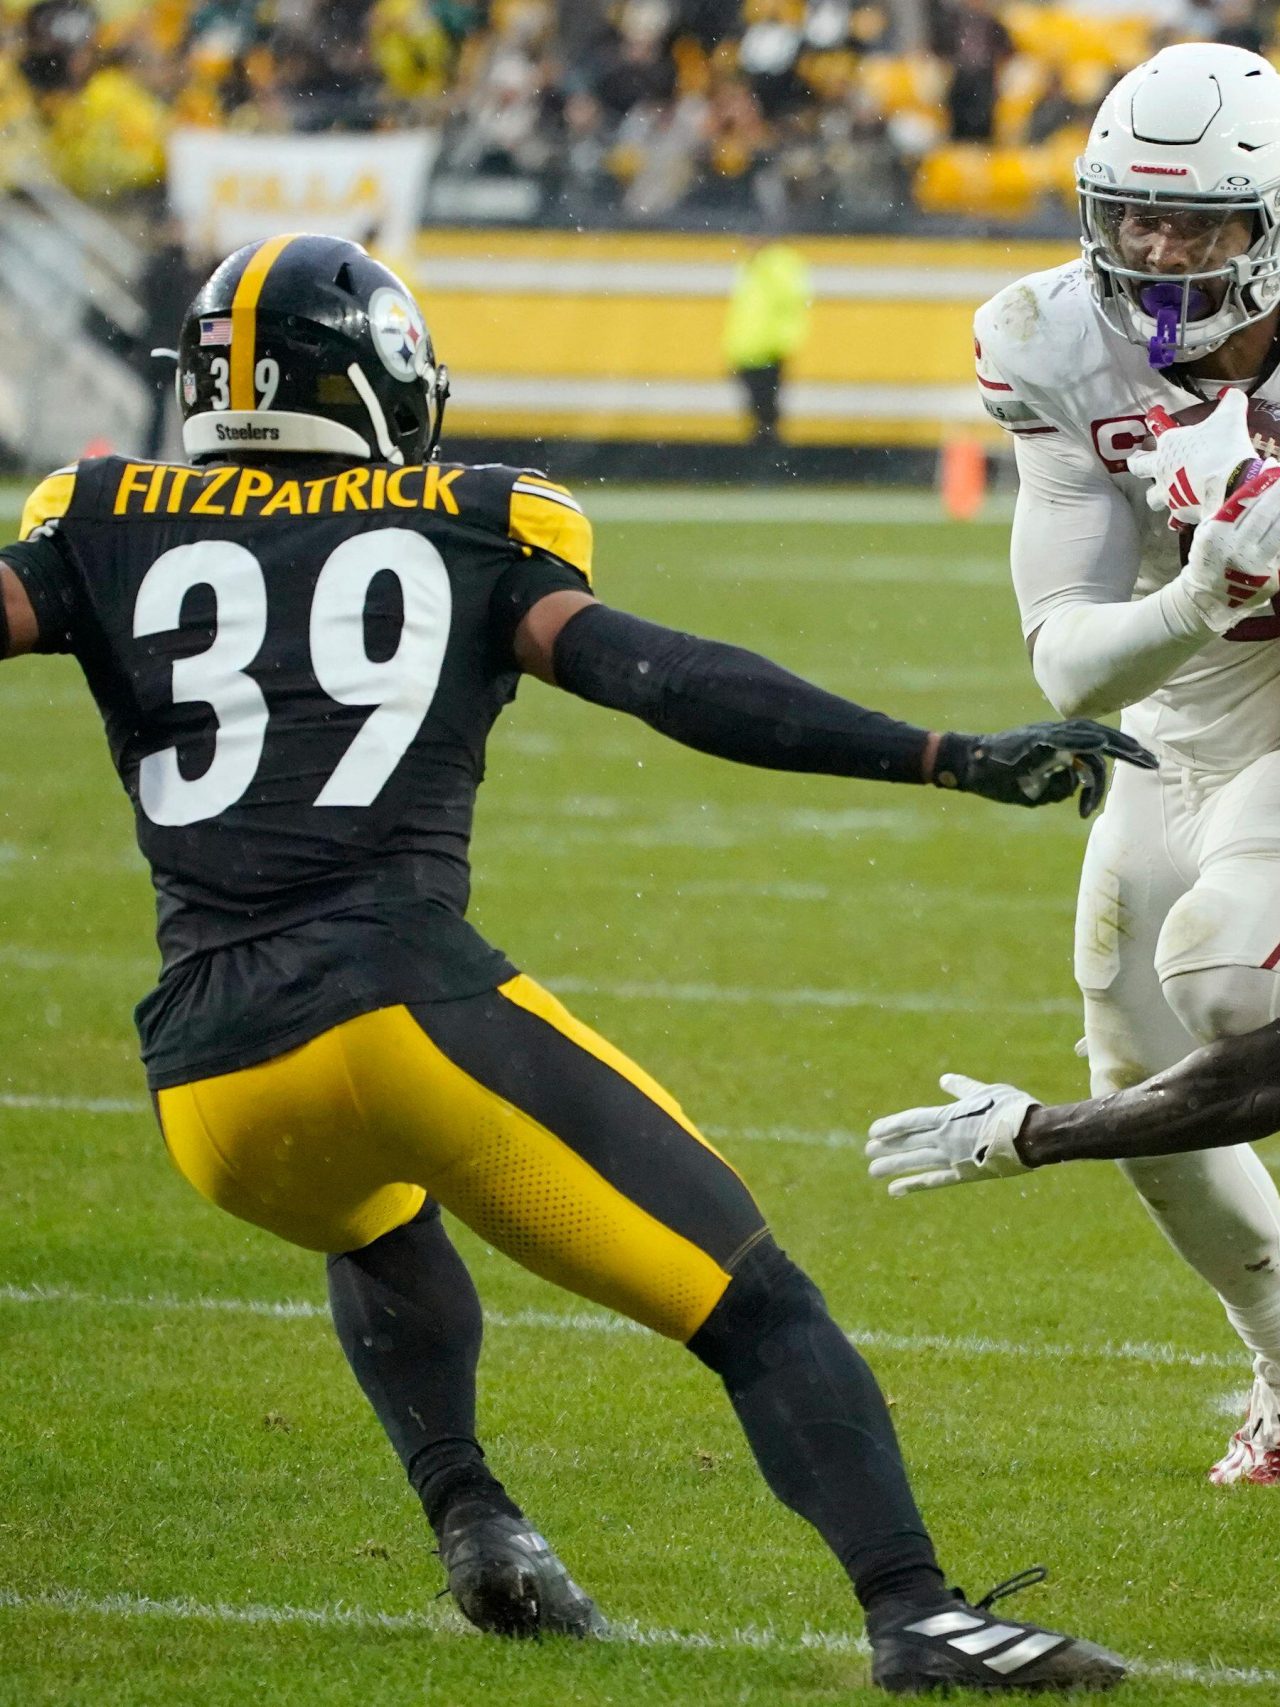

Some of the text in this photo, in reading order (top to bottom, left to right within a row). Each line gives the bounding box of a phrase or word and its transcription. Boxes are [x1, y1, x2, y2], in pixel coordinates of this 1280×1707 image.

[1130, 165, 1187, 176] CARDINALS
[216, 422, 279, 441] Steelers
[113, 464, 465, 516] FITZPATRICK
[132, 526, 453, 828] 39
